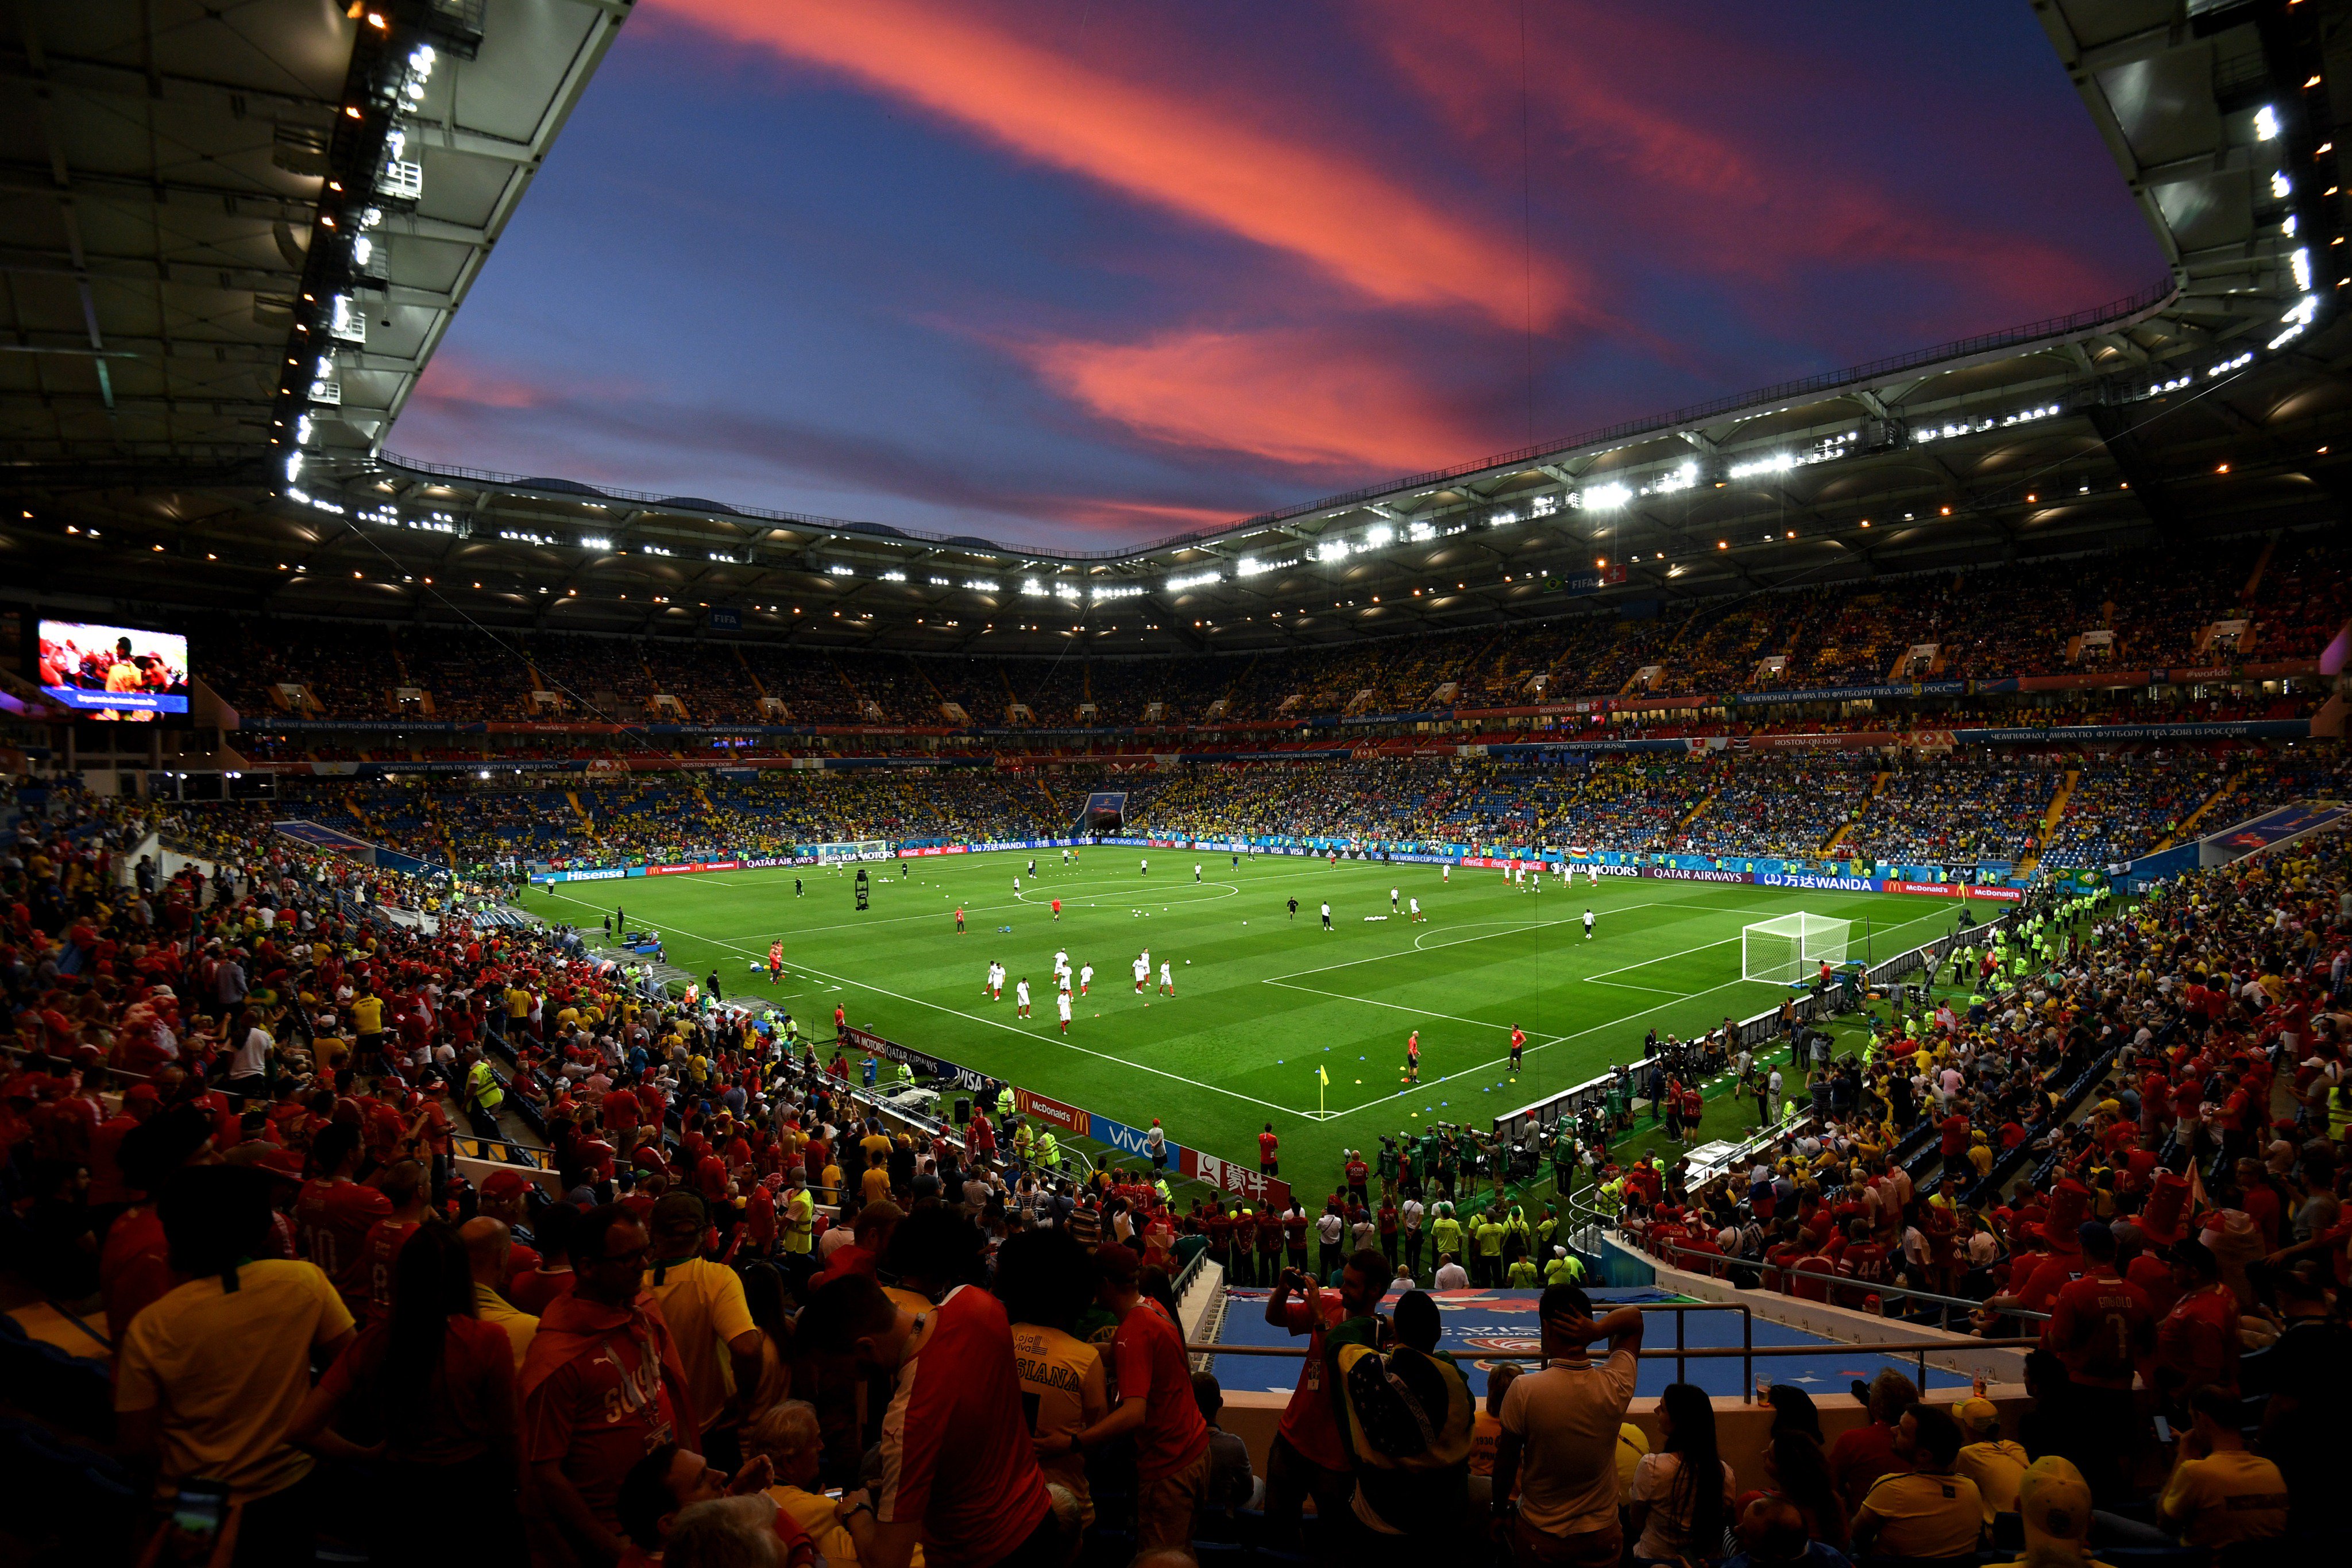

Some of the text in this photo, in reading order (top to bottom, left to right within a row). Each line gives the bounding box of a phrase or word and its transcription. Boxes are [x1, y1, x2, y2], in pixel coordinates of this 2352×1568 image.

[1573, 578, 1594, 589] FIFA
[714, 614, 737, 624] FIFA
[2187, 669, 2231, 678] #worldc
[1743, 694, 1789, 702] ЧЕМПИОНАТ
[1832, 688, 1871, 698] ФУТБОЛУ
[1925, 685, 1959, 693] РОСС
[2096, 729, 2144, 737] ФУТБОЛУ
[2204, 727, 2247, 735] РОССИИ
[1775, 737, 1841, 746] ROSTOV-ON-DON
[1269, 847, 1284, 855] VISA
[841, 853, 858, 862] KIA
[747, 859, 776, 868] QATAR
[567, 870, 625, 881] Hisense
[1654, 868, 1742, 883] QATAR AIRWAYS
[1906, 885, 1948, 893] McDonald's
[1974, 889, 2019, 898] McDonald's
[862, 1036, 885, 1054] MOTORS
[955, 1066, 982, 1092] VISA
[1032, 1100, 1071, 1122] McDonald's
[1226, 1165, 1268, 1203] 蒙牛
[1857, 1260, 1881, 1280] 44
[2098, 1296, 2133, 1308] EMBOLO
[1014, 1333, 1034, 1345] loja
[2105, 1314, 2129, 1358] 7
[1016, 1357, 1081, 1393] SIANA
